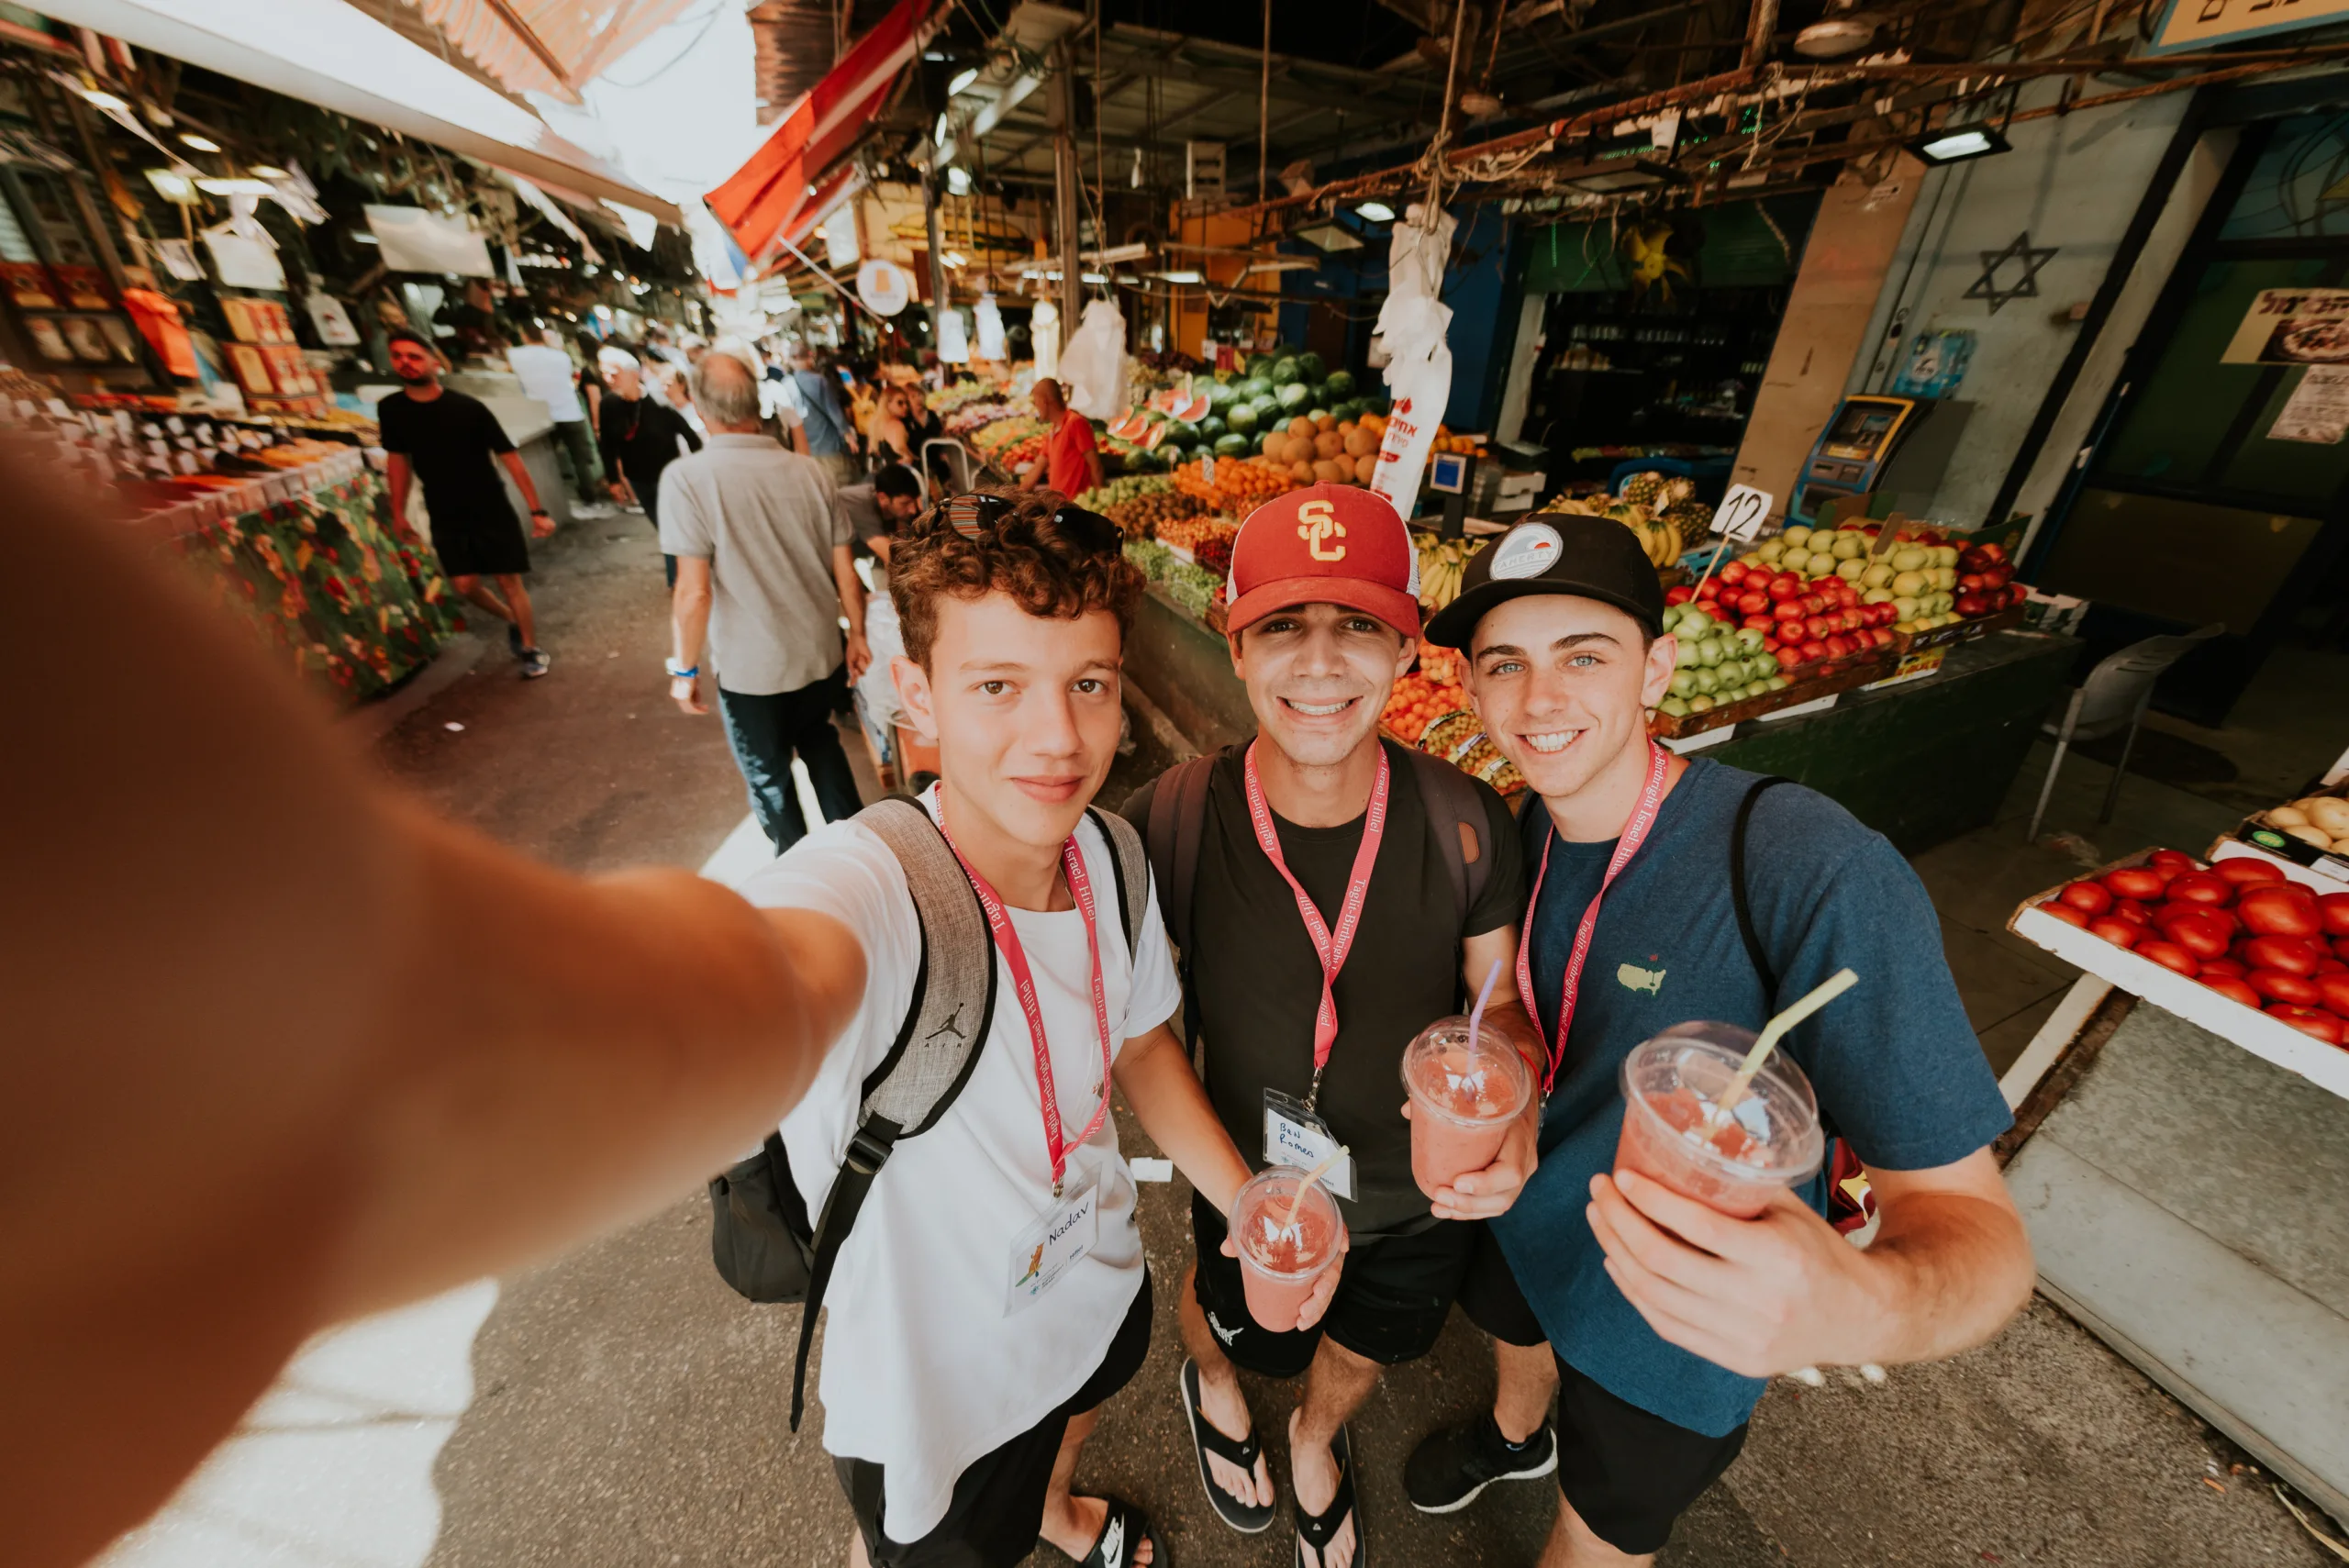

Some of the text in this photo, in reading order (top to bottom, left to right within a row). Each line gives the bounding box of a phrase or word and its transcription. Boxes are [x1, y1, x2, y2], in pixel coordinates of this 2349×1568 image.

[1297, 500, 1346, 562] SC
[1721, 492, 1761, 539] 12
[1369, 801, 1384, 833] Hillel
[1625, 809, 1653, 845] Israel:
[1609, 847, 1633, 876] Hillel
[1309, 916, 1330, 951] Israel:
[1020, 979, 1037, 1018] Hillel
[1030, 1015, 1045, 1055] Israel:
[1048, 1201, 1089, 1246] Nadav
